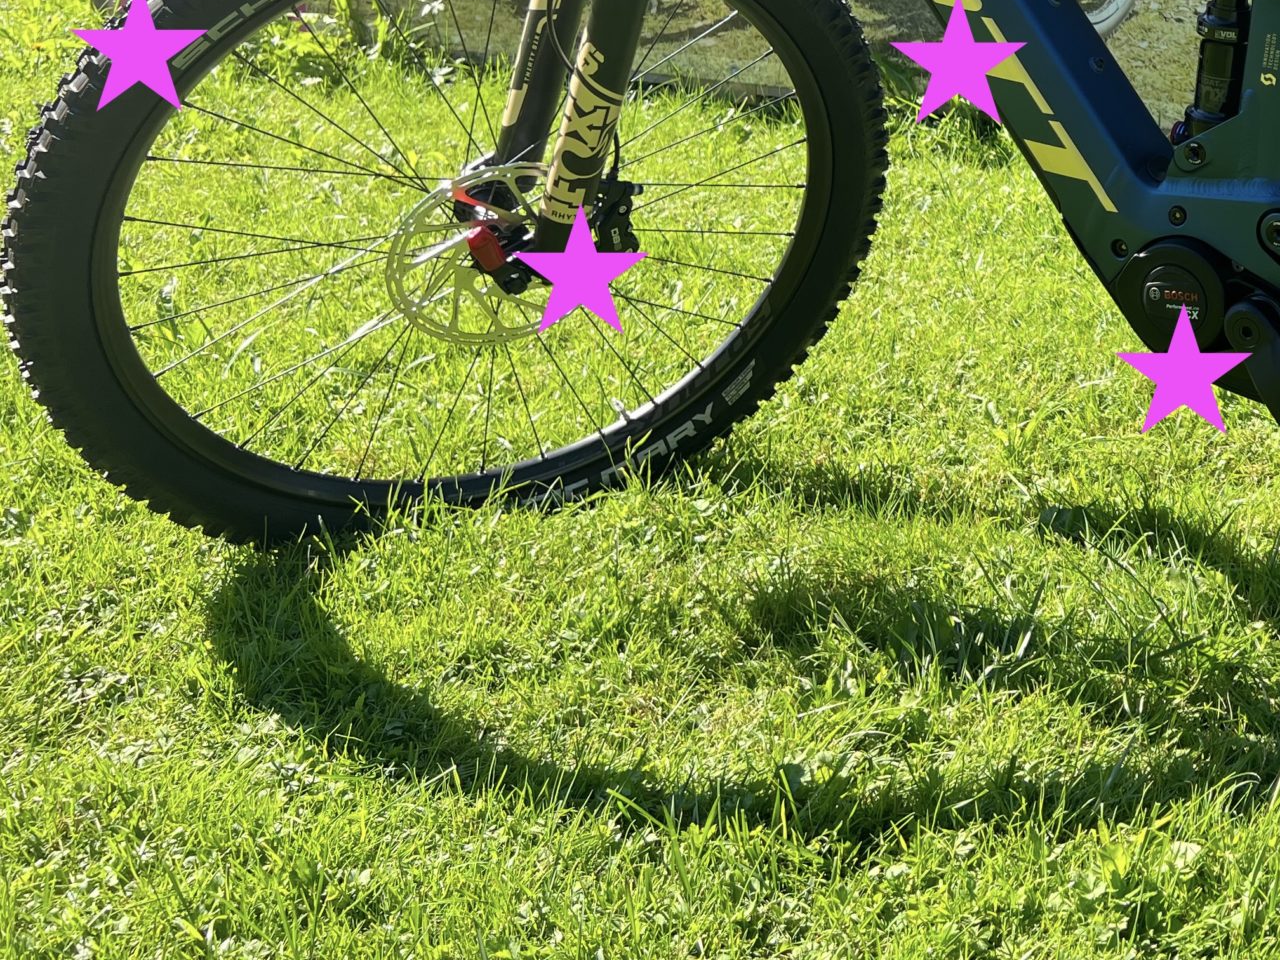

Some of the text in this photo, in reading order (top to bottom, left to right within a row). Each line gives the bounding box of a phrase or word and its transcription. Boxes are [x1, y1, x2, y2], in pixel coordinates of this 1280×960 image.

[524, 31, 542, 83] THIRTY SIX
[1164, 290, 1199, 302] BOSCH
